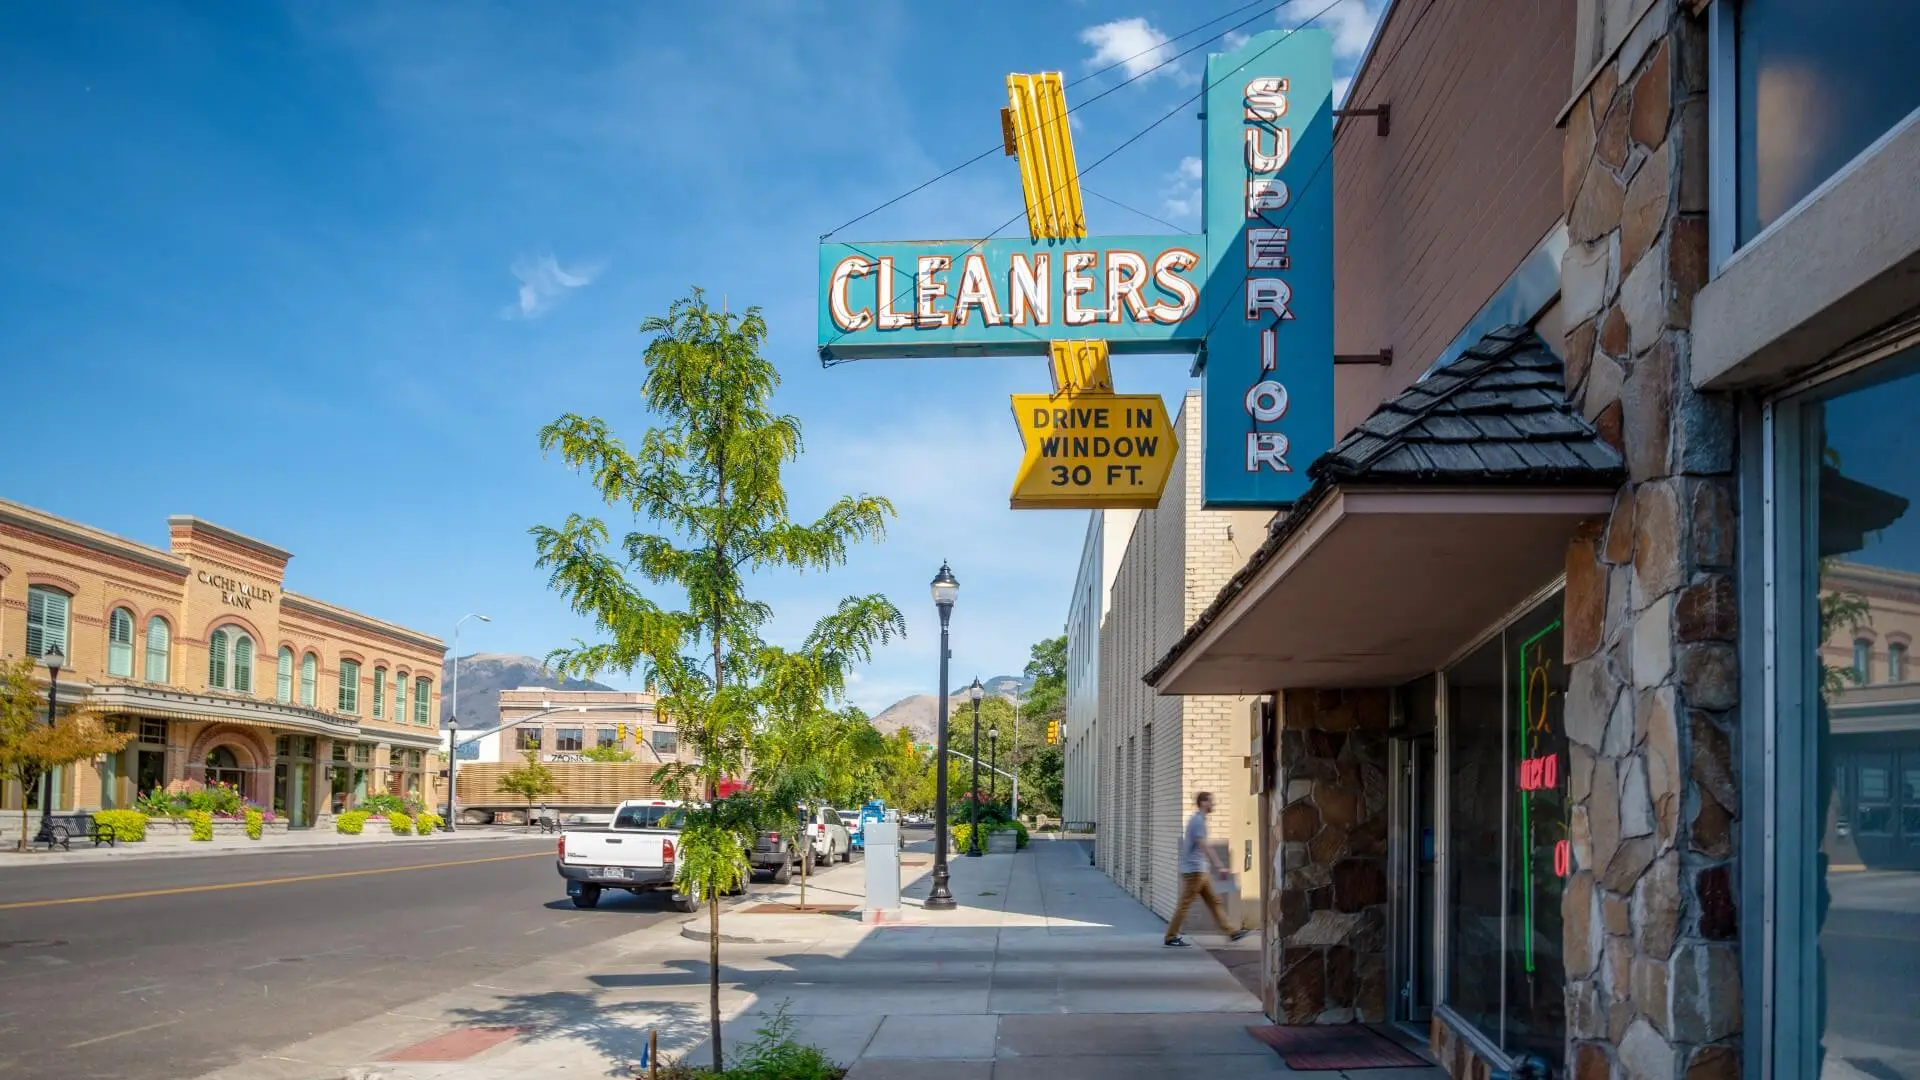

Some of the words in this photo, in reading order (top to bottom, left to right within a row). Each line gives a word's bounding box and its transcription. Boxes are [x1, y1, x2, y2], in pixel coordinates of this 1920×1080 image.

[1244, 75, 1294, 473] SUPERIOR
[829, 248, 1201, 331] CLEANERS
[1033, 408, 1110, 429] DRIVE
[1126, 408, 1153, 429] IN
[1039, 436, 1159, 458] WINDOW
[1050, 464, 1092, 487] 30
[1106, 465, 1144, 486] FT.
[197, 570, 236, 593] CACHE
[238, 581, 273, 603] VALLEY
[222, 590, 252, 610] BANK
